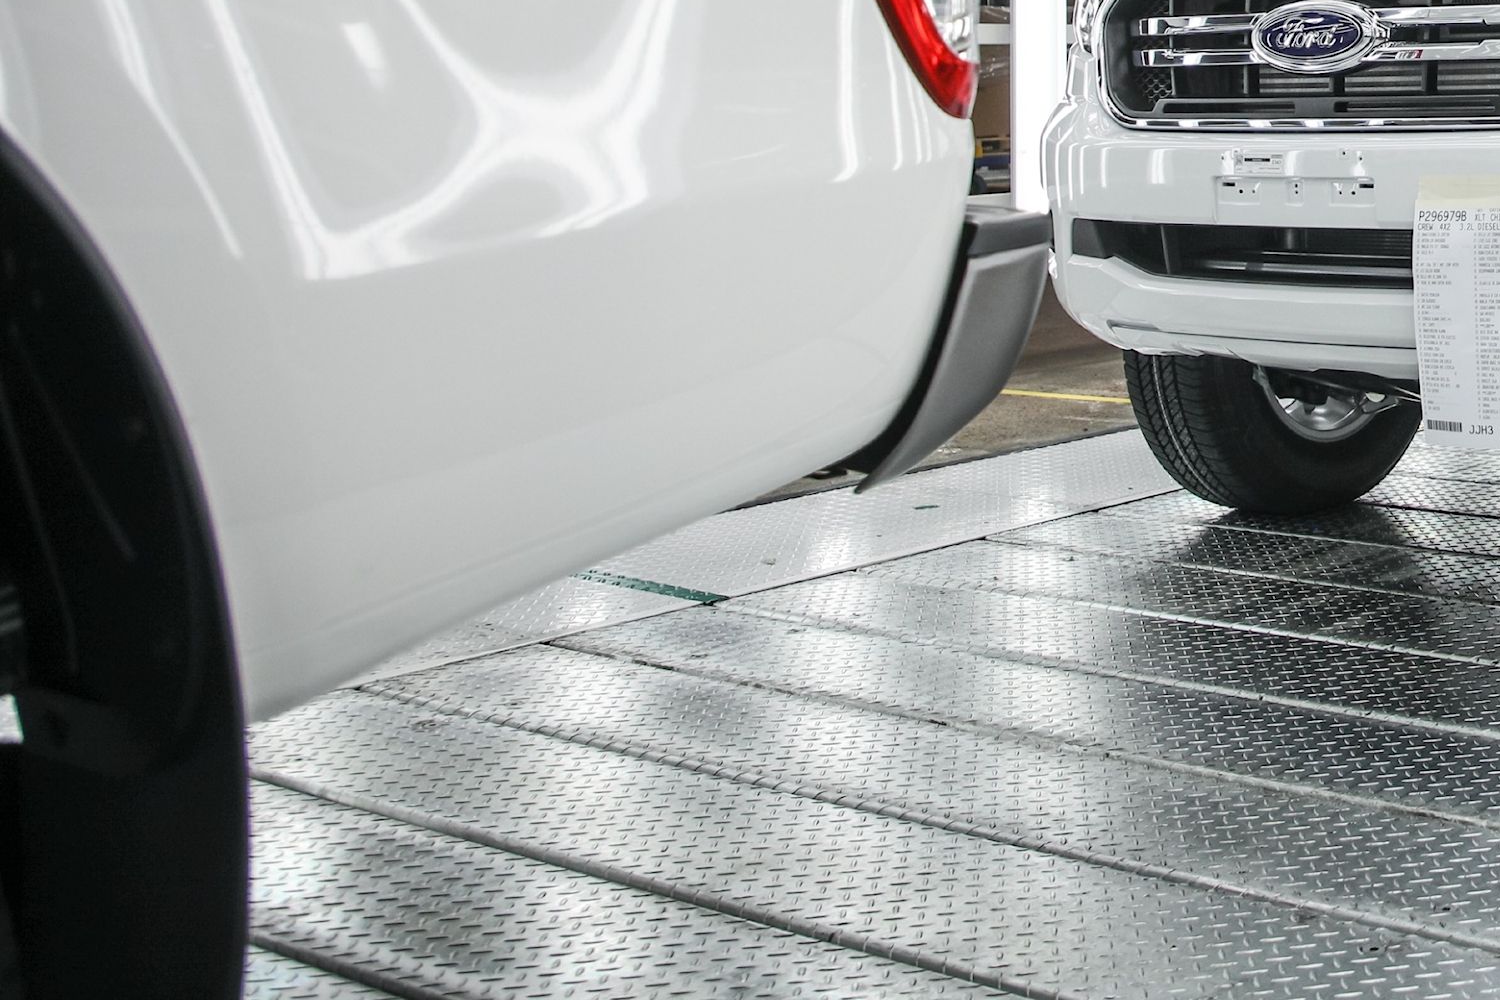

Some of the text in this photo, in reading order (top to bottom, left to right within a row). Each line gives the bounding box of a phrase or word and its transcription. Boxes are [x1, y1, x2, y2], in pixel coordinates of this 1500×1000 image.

[1272, 18, 1342, 48] Ford
[1418, 210, 1467, 222] P296979B
[1474, 213, 1486, 222] XLT
[1417, 222, 1434, 231] CREW
[1477, 222, 1500, 231] DIESEL
[1469, 424, 1494, 435] JJH3
